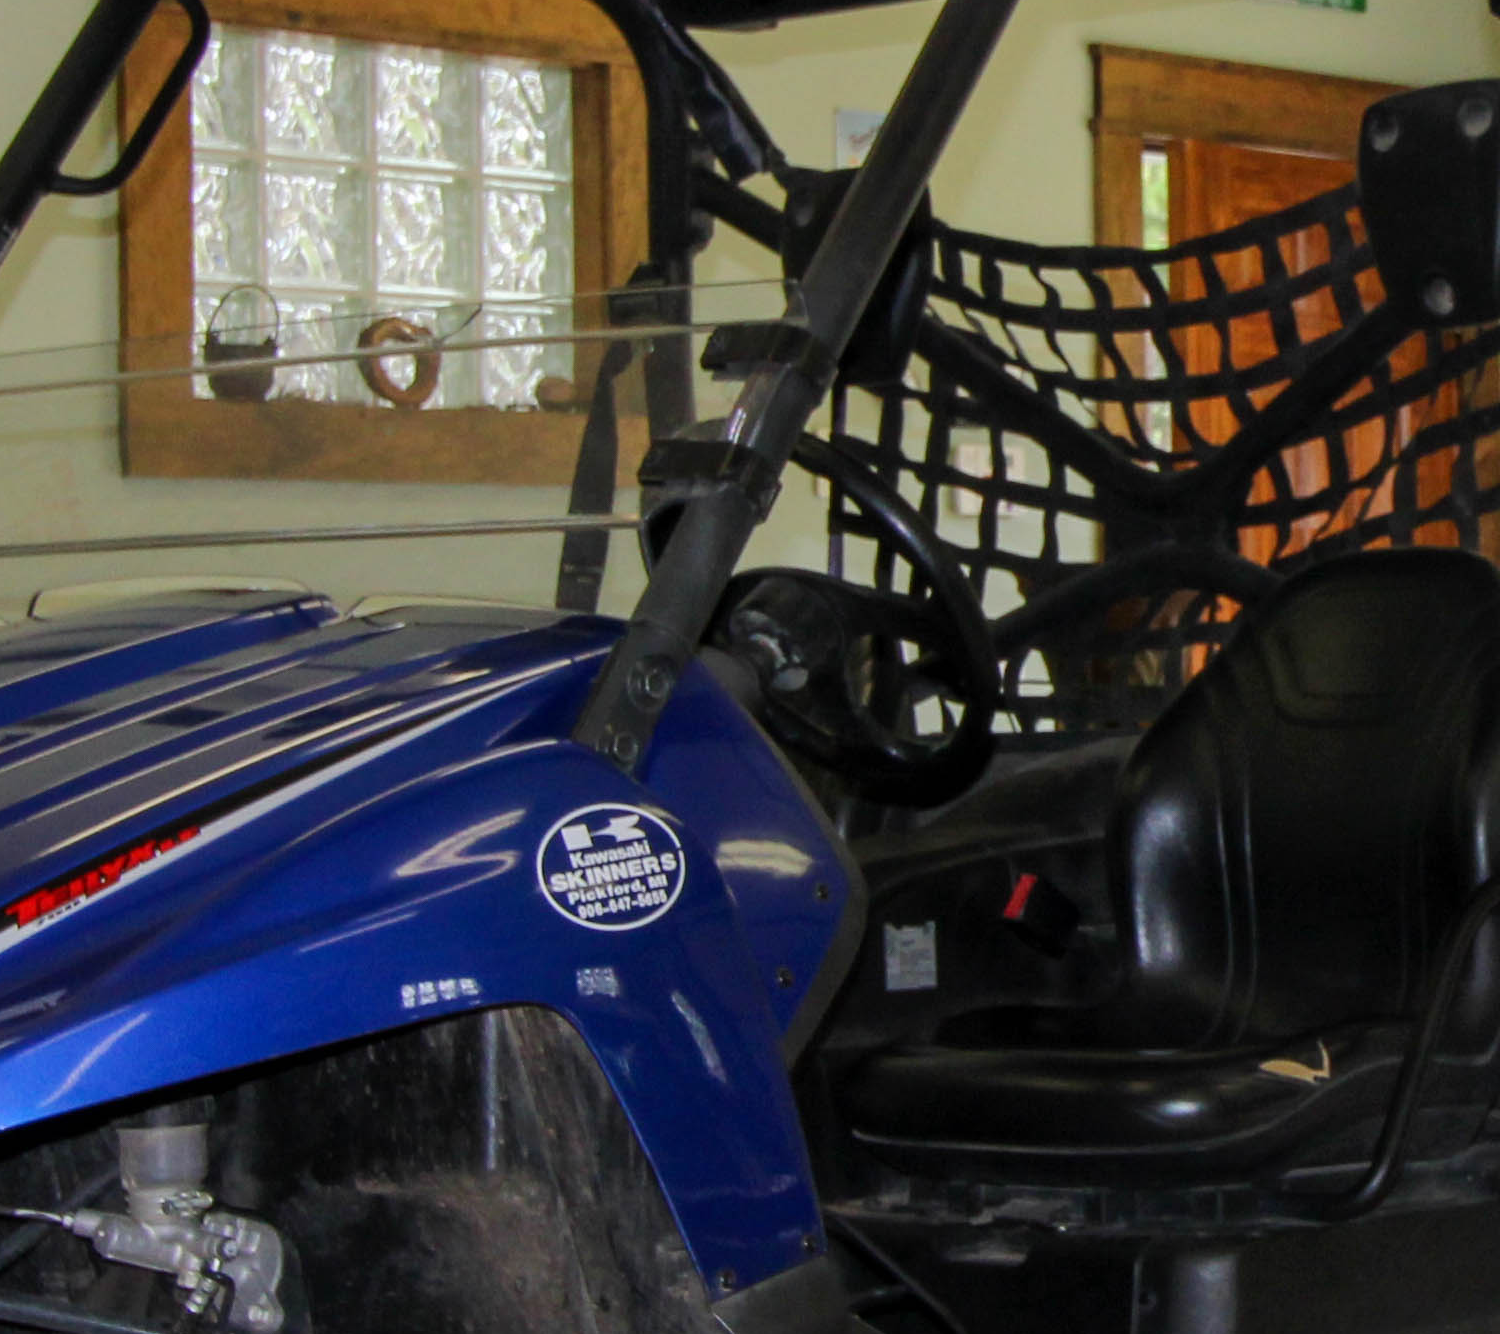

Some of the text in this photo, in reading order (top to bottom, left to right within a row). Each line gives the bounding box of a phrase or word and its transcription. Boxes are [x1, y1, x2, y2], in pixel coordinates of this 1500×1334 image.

[570, 839, 650, 869] Kawasaki
[550, 853, 678, 893] SKINNERS
[567, 874, 669, 906] Pickford, MI
